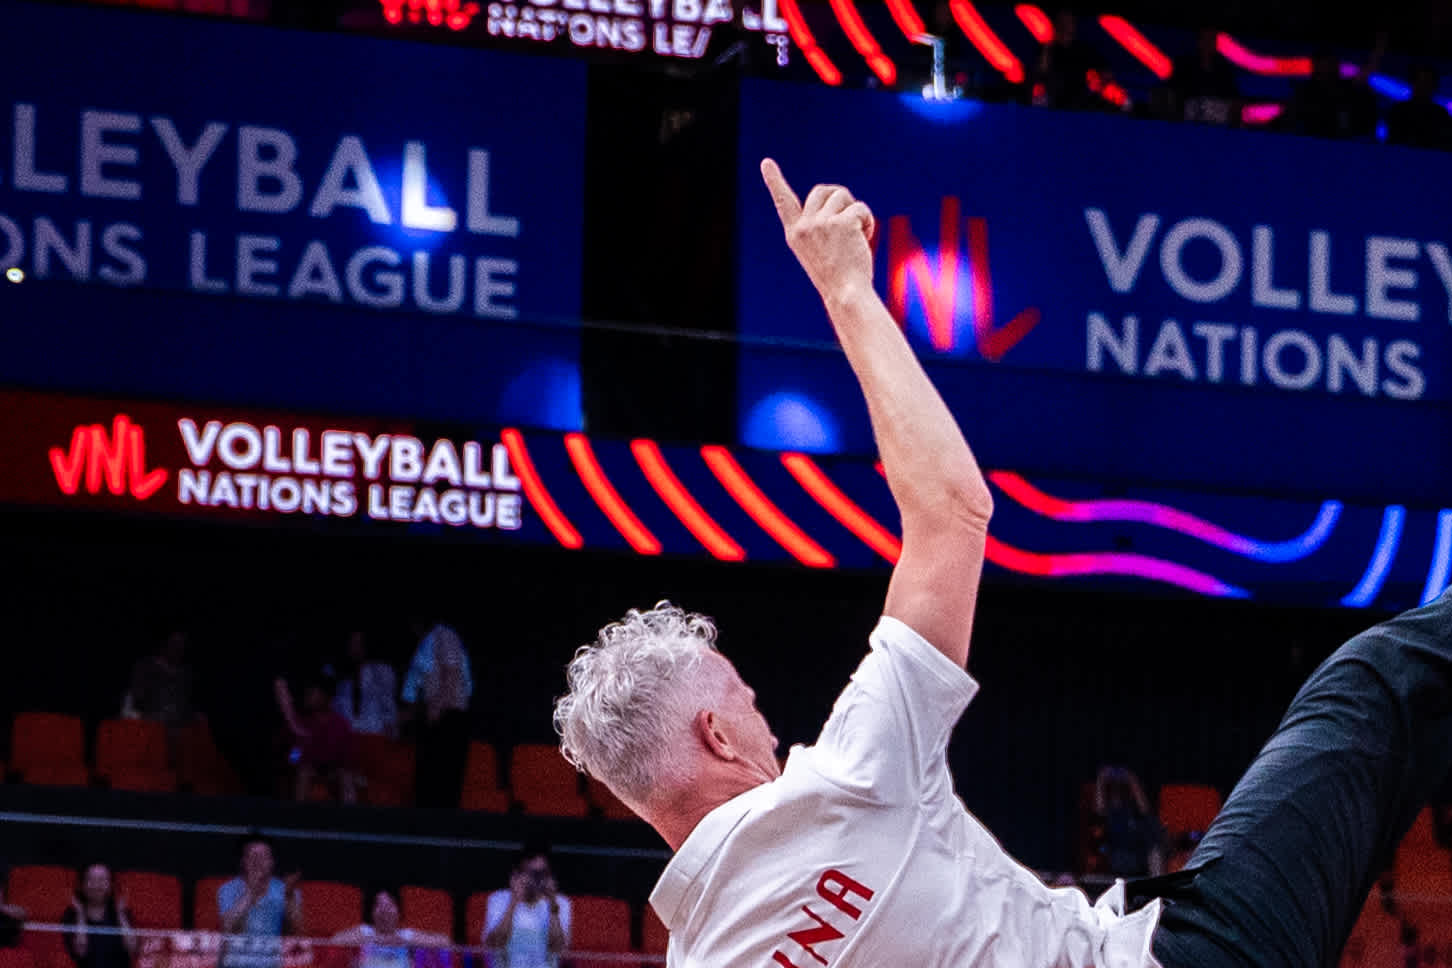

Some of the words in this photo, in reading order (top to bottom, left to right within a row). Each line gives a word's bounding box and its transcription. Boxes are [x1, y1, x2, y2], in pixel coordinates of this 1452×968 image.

[0, 103, 519, 238] LEYBALL
[190, 229, 518, 320] LEAGUE
[1086, 311, 1424, 400] NATIONS
[177, 417, 521, 490] VOLLEYBALL
[178, 468, 358, 516] NATIONS
[368, 483, 522, 530] LEAGUE
